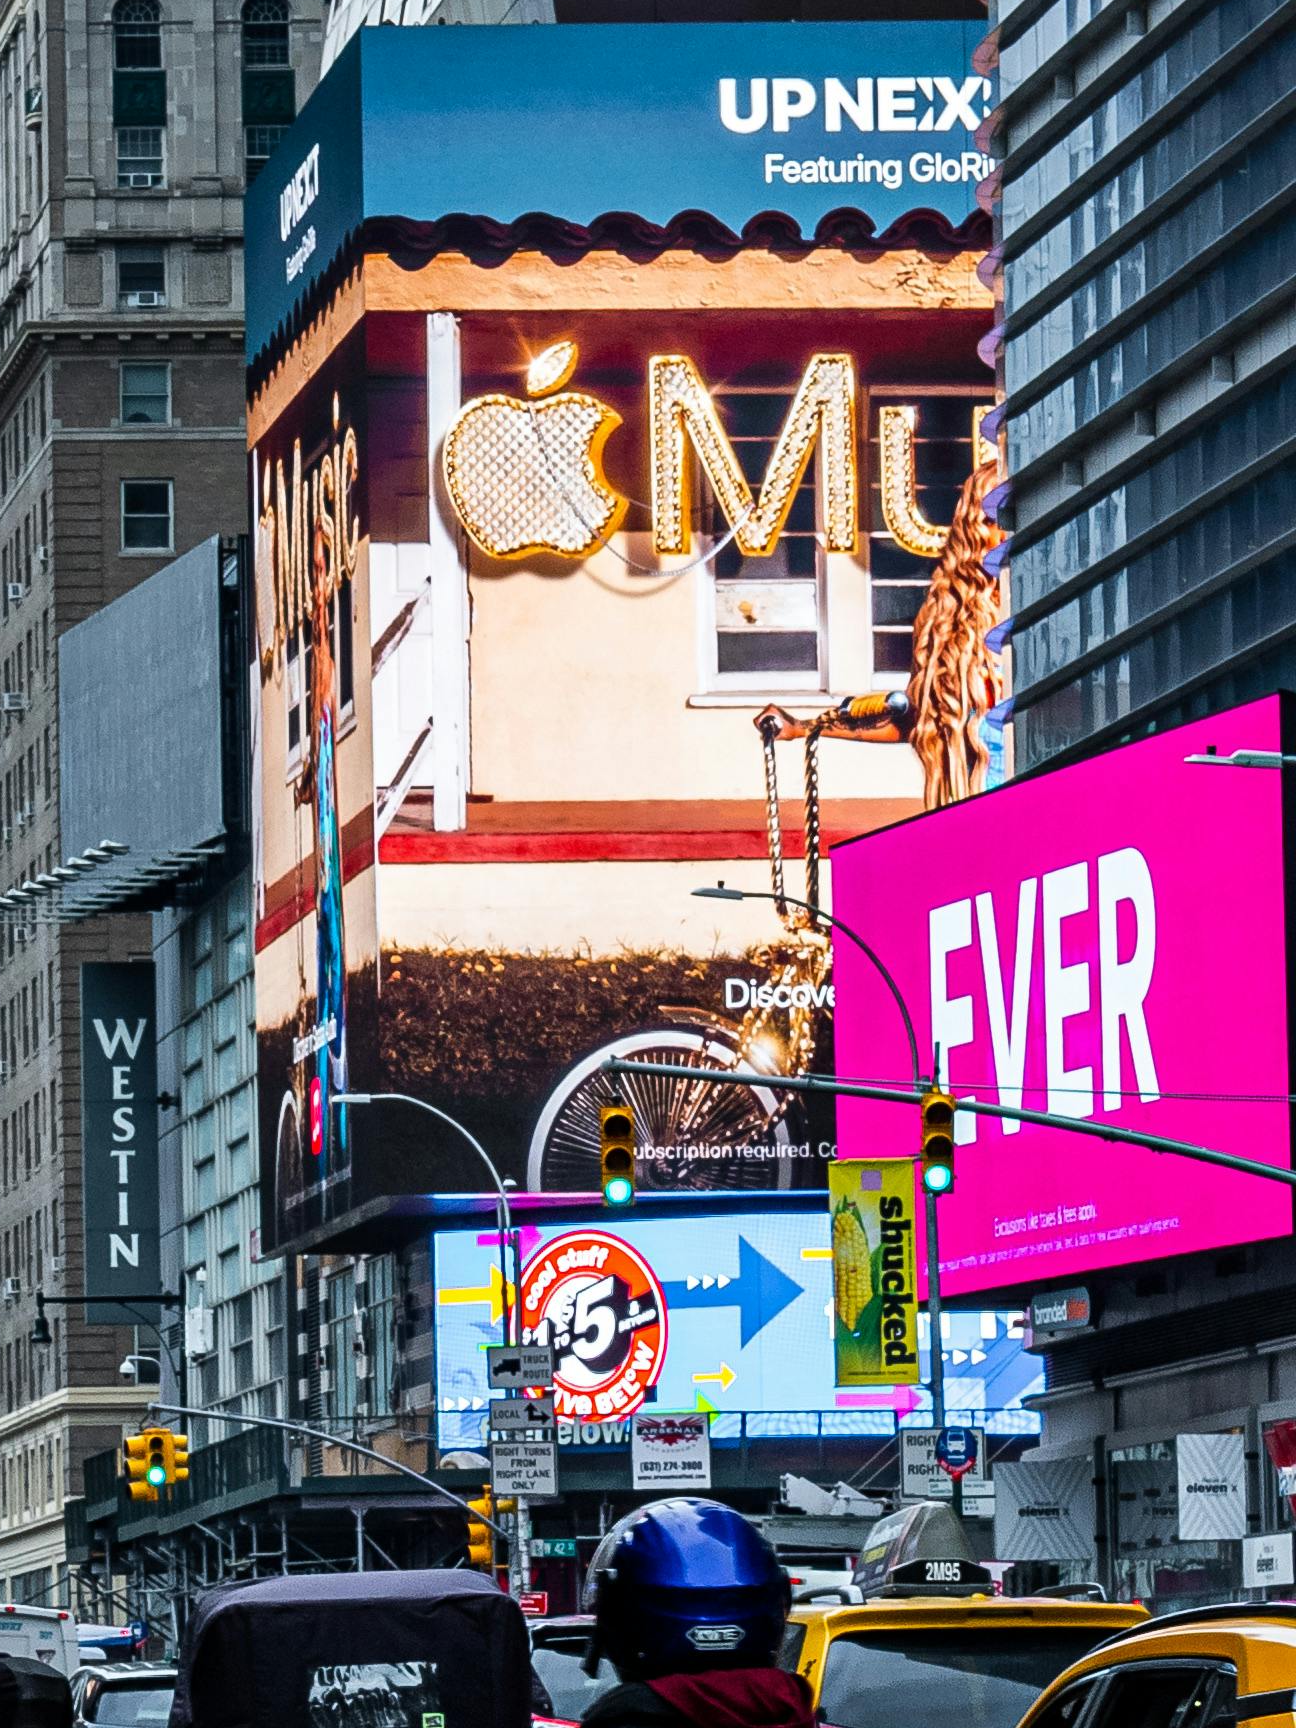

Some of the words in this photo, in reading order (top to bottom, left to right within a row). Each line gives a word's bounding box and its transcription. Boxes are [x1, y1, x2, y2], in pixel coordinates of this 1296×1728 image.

[719, 77, 817, 134] UP
[824, 76, 992, 133] NEX
[764, 153, 903, 189] Featuring
[929, 846, 1161, 1148] EVER
[93, 1018, 147, 1268] WESTIN
[634, 1142, 733, 1160] ubscription
[737, 1142, 814, 1160] required.
[525, 1260, 558, 1311] cool
[557, 1244, 610, 1273] stuff
[879, 1196, 917, 1367] shucked
[523, 1354, 549, 1365] TRUCK
[523, 1369, 550, 1380] ROUTE
[554, 1383, 593, 1415] ive
[493, 1408, 521, 1420] LOCAL
[641, 1426, 699, 1435] ARSENAL
[495, 1446, 519, 1457] RIGHT
[524, 1446, 552, 1457] TURNS
[510, 1458, 537, 1468] FROM
[495, 1469, 522, 1479] RIGHT
[526, 1469, 551, 1479] LANE
[511, 1480, 536, 1490] ONLY
[1186, 1482, 1228, 1494] eleven
[1018, 1506, 1060, 1518] eleven
[925, 1562, 961, 1582] 2M95
